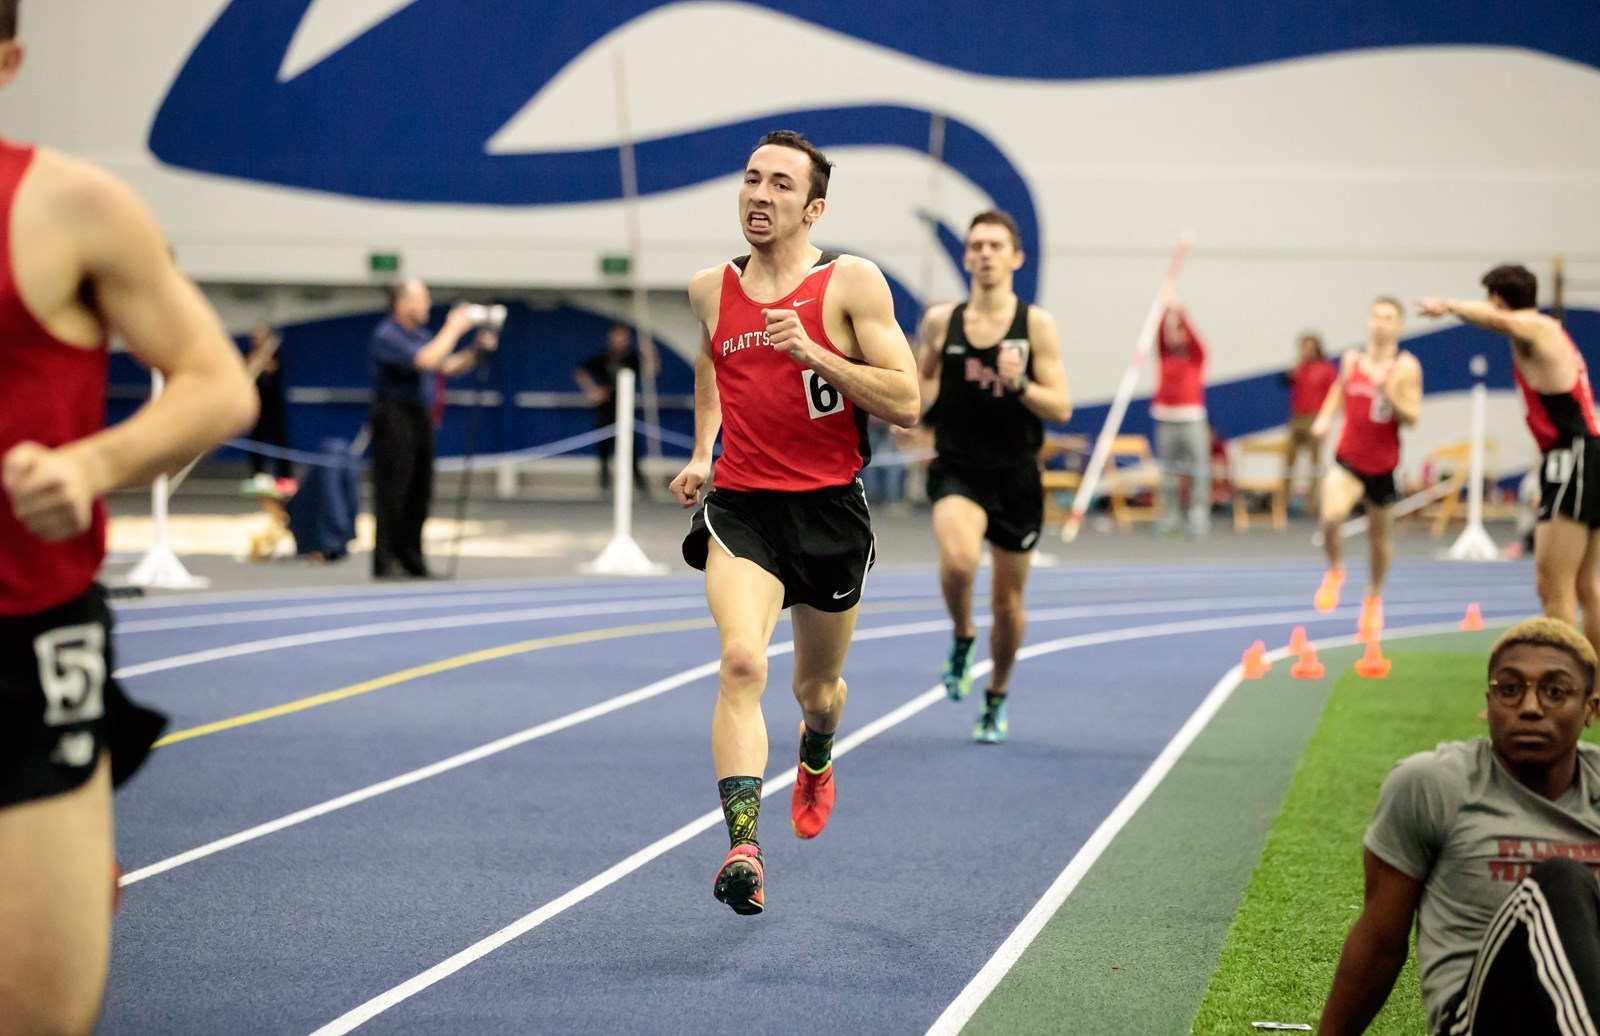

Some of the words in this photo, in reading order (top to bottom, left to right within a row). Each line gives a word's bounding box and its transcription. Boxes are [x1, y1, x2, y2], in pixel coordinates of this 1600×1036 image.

[722, 331, 774, 356] PLATTS
[810, 372, 838, 413] 6
[54, 638, 92, 711] 5
